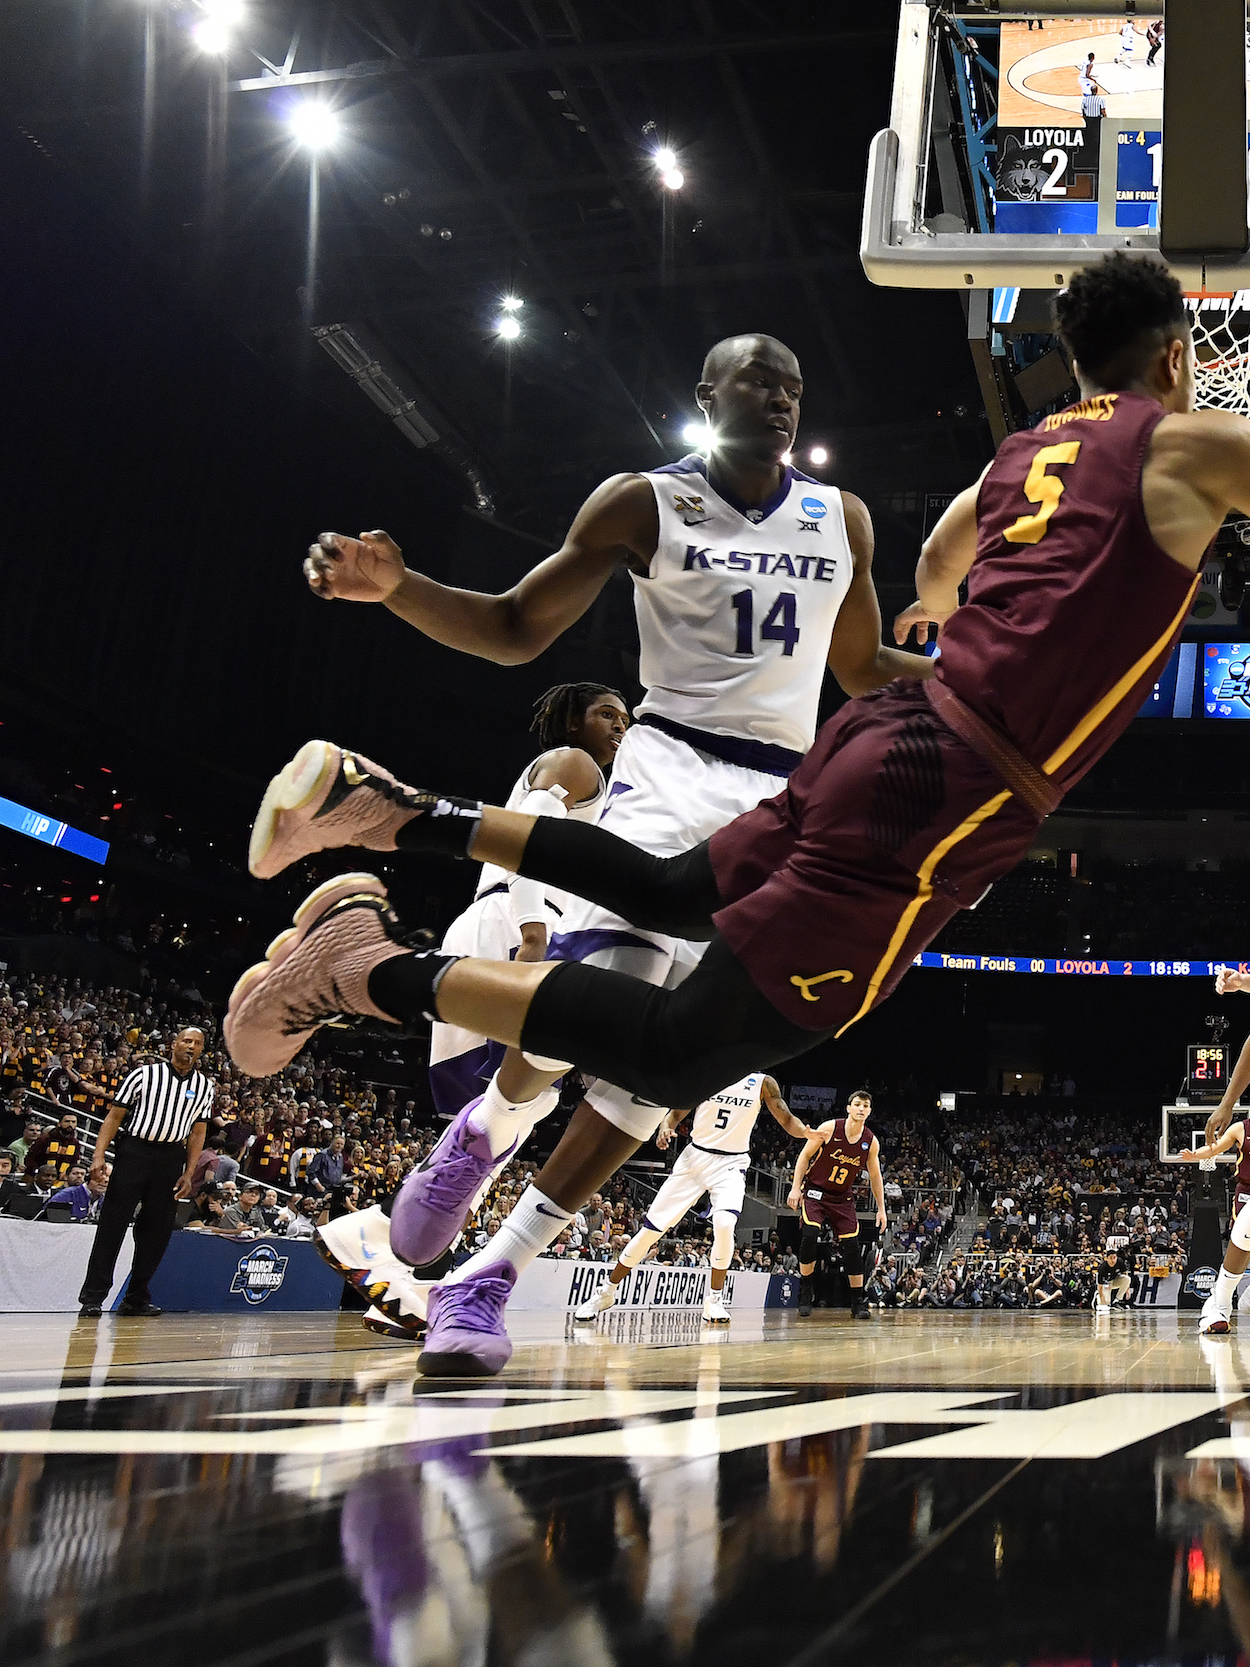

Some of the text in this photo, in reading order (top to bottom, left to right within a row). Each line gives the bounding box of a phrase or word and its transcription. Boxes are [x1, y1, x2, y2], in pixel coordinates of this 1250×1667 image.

[1024, 128, 1084, 147] LOYOLA
[1118, 131, 1145, 146] OL: 4
[1042, 148, 1068, 196] 2
[1116, 191, 1133, 200] EAM
[1002, 440, 1081, 544] 5
[683, 544, 837, 583] K-STATE
[731, 588, 800, 657] 14
[913, 954, 922, 966] 4
[941, 954, 976, 969] Team
[980, 957, 1016, 971] Fouls
[1030, 959, 1045, 973] 00
[1056, 960, 1109, 975] LOYOLA
[1123, 962, 1132, 975] 2
[1149, 961, 1190, 975] 18:56
[1196, 1049, 1223, 1060] 18:56
[711, 1094, 753, 1107] -STATE
[714, 1108, 731, 1130] 5
[829, 1148, 861, 1168] Loyola
[828, 1165, 848, 1185] 13
[247, 1260, 275, 1273] MARCH
[248, 1272, 283, 1285] MADNESS
[568, 1267, 632, 1305] HOSD
[632, 1269, 653, 1305] BY
[655, 1271, 706, 1305] GEORGIA
[1194, 1274, 1216, 1282] MARCH
